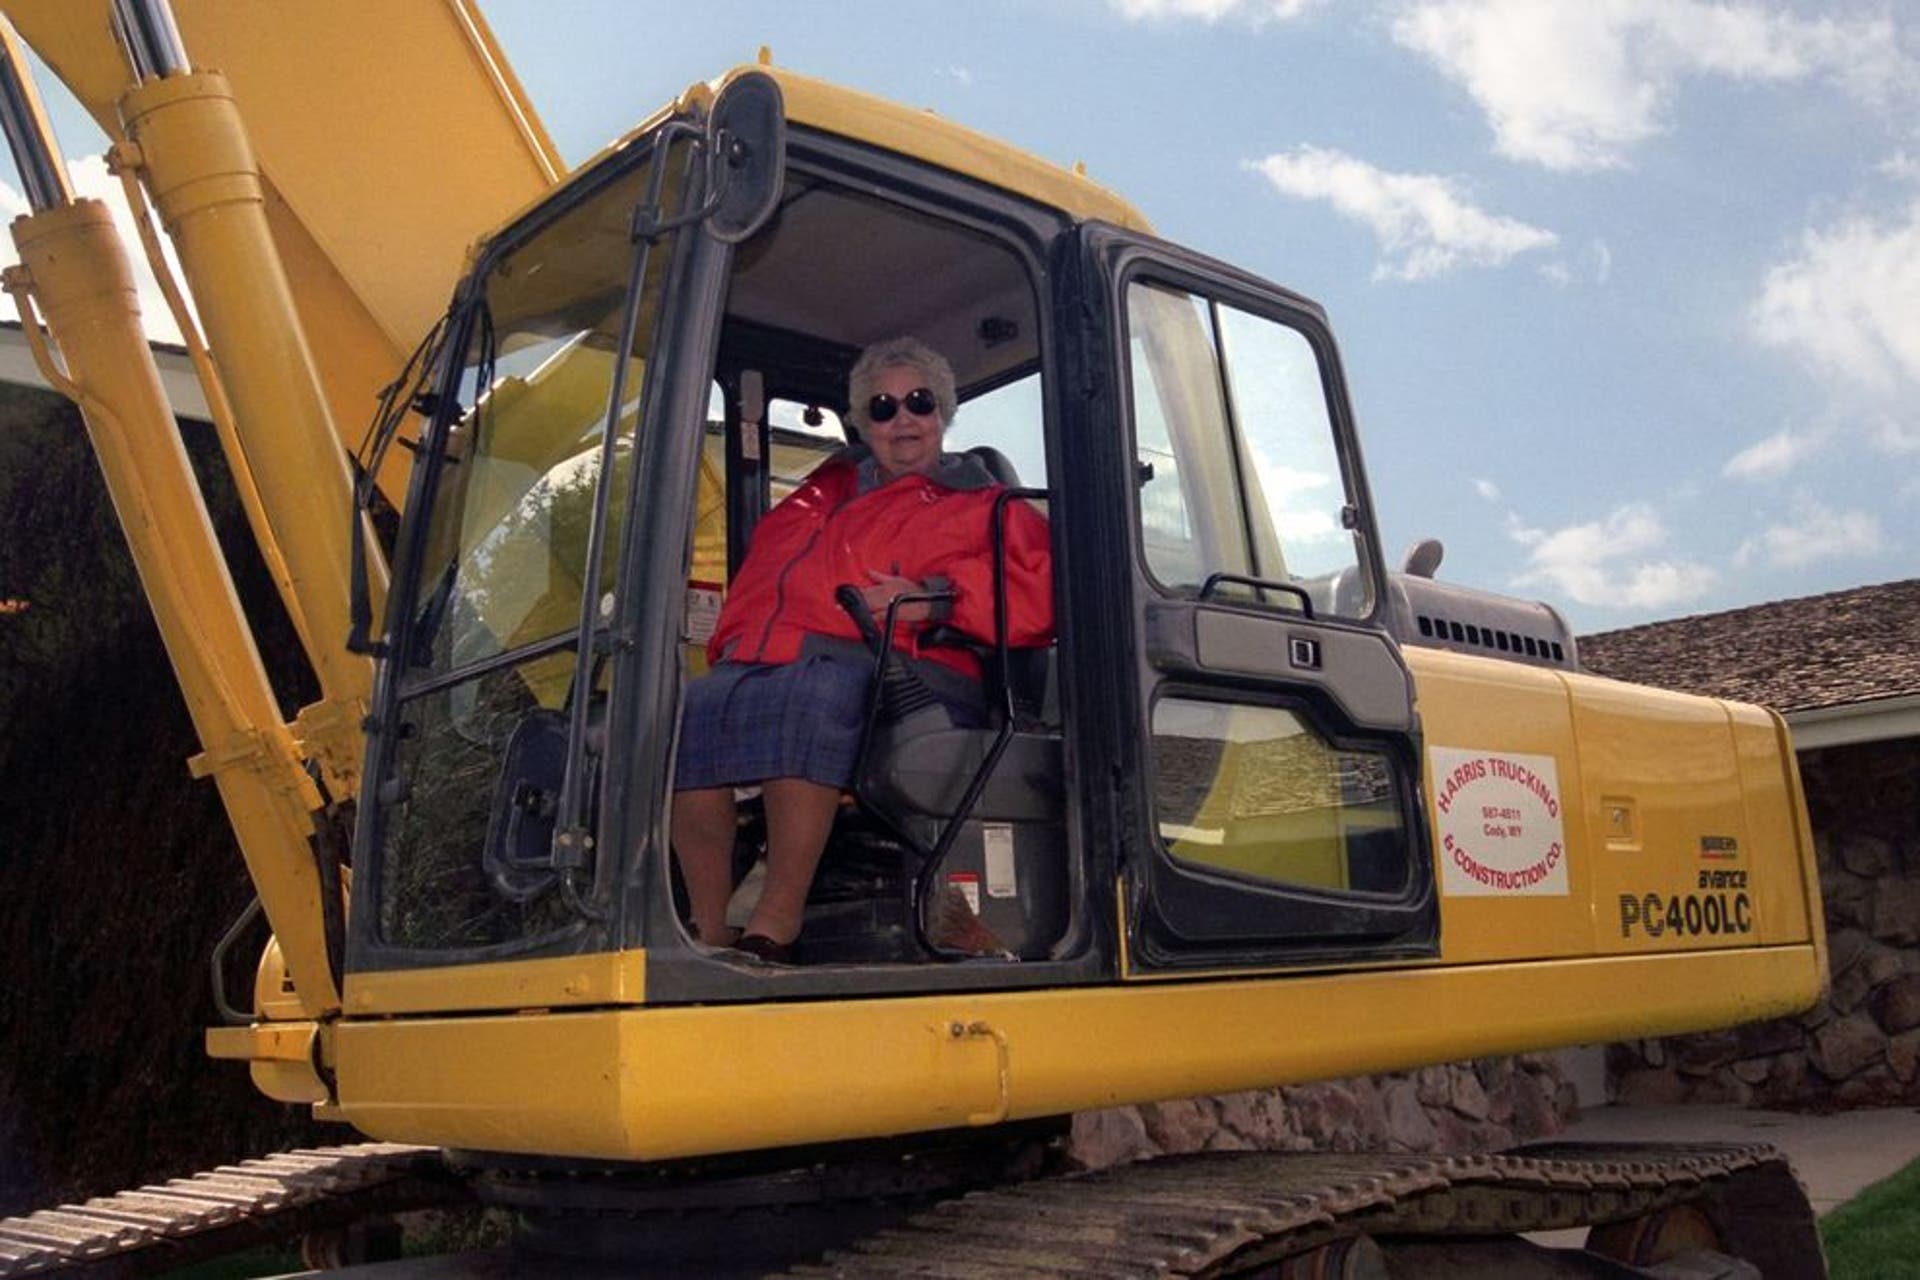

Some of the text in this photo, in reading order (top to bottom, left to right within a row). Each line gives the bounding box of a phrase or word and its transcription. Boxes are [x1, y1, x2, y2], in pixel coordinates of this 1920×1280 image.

[1438, 758, 1558, 818] HARRIS TRUCKING
[1454, 848, 1548, 890] CONSTRUCTION
[1699, 870, 1747, 889] avance
[1620, 893, 1752, 938] PC400LC
